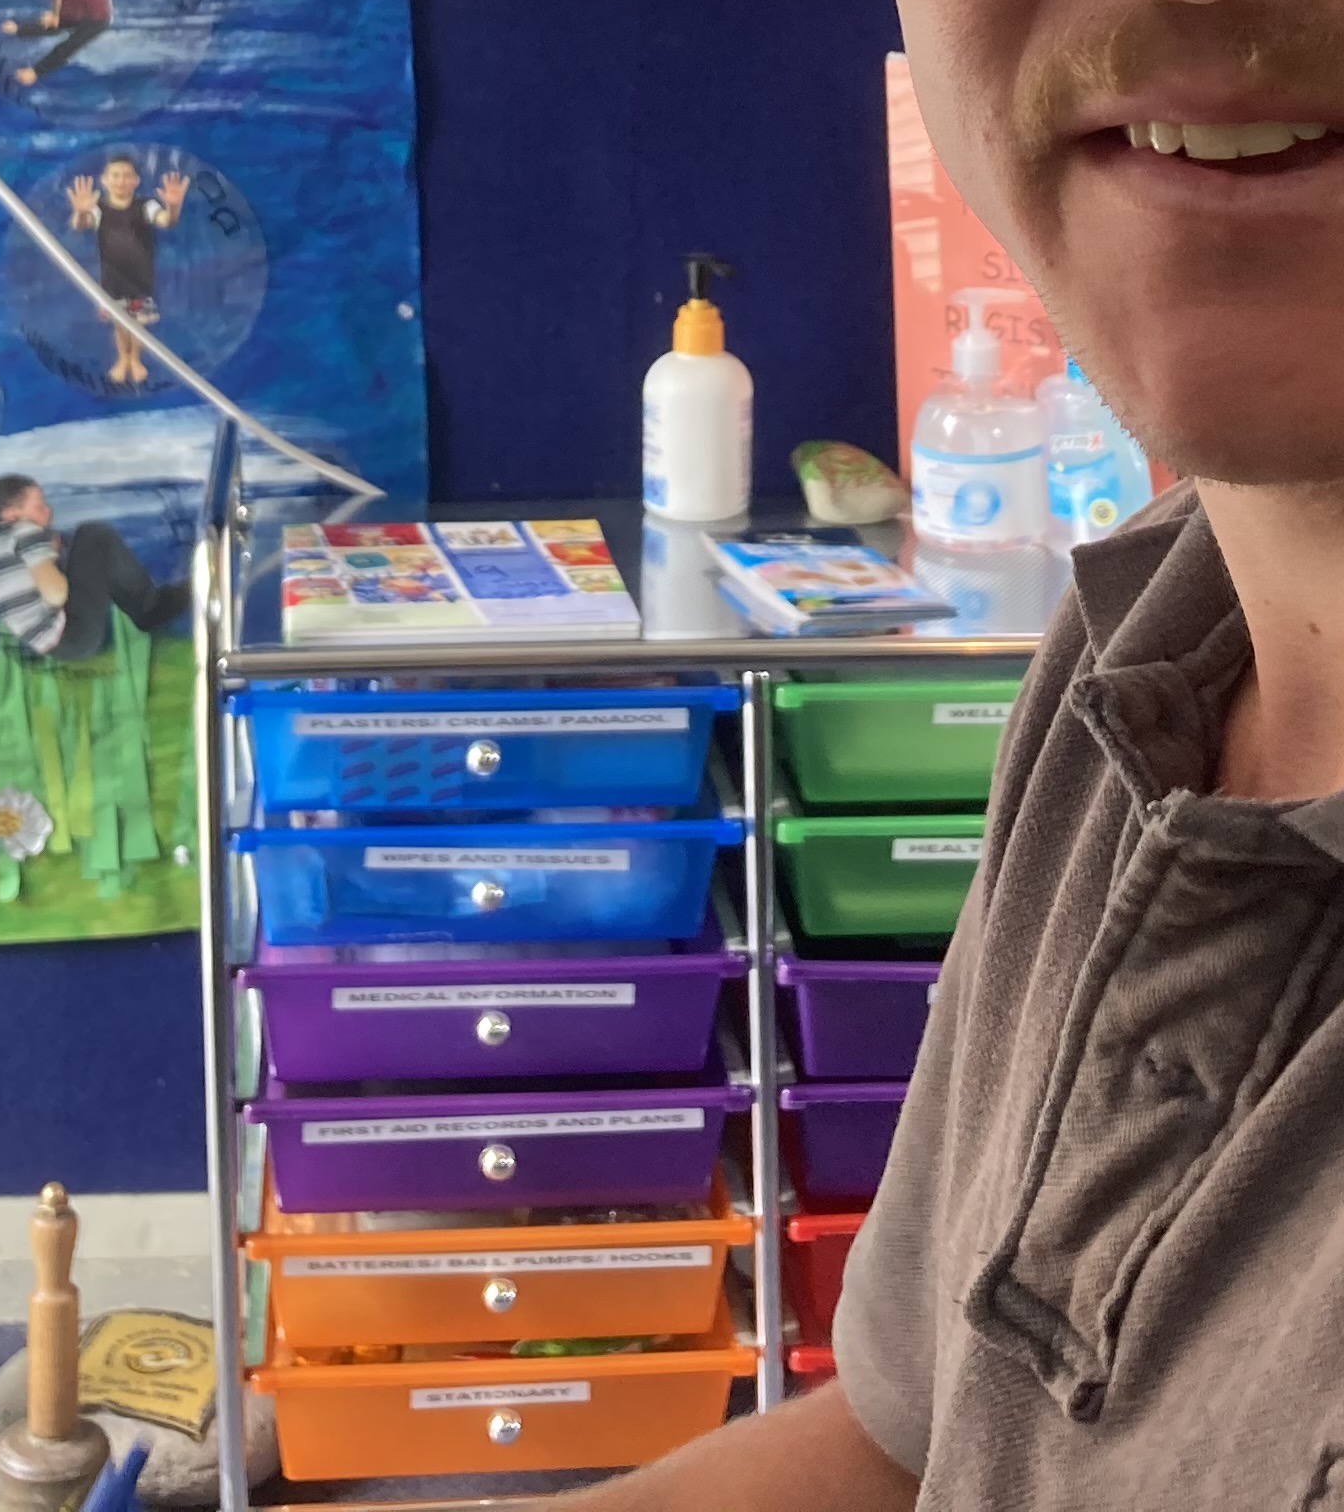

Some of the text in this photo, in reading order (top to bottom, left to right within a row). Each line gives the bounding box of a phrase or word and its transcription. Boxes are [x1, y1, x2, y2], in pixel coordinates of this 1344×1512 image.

[944, 304, 1047, 346] RGIS
[310, 716, 440, 730] PLASTERS/
[559, 713, 669, 726] PANADOL
[382, 852, 611, 865] WIPES AND TISSUES
[348, 988, 618, 1003] MEDICAL INFORMATION
[318, 1112, 686, 1138] FIRST AID RECORDS AND PLANS
[306, 1250, 694, 1272] BATTERIES/ BALL PUMPS/ HOOKS
[426, 1386, 572, 1402] STATIONARY
